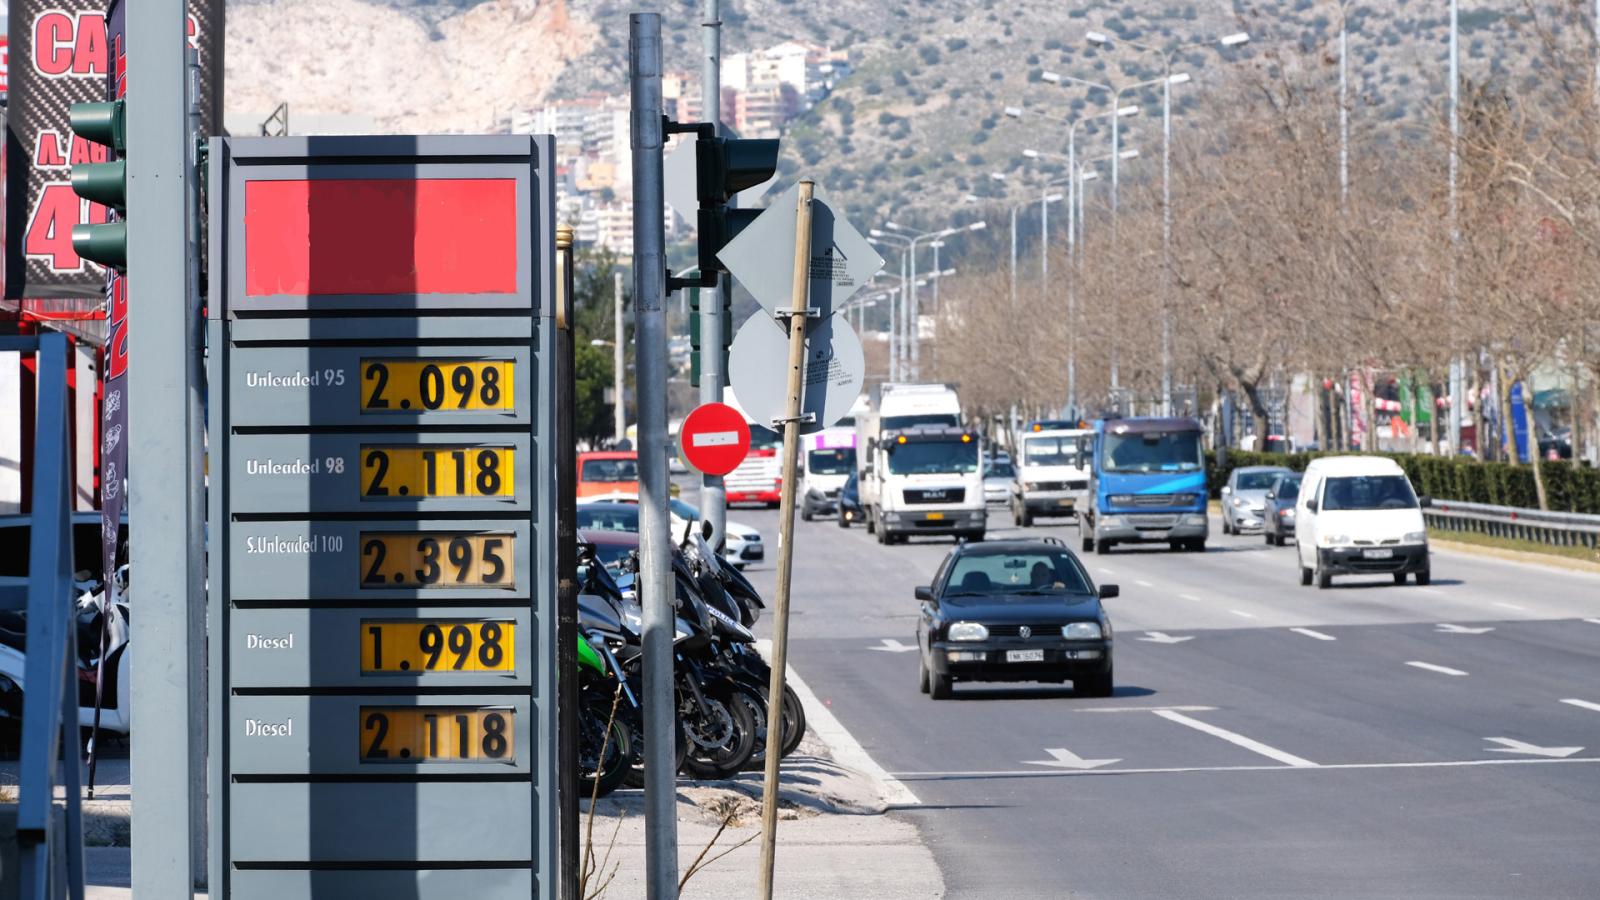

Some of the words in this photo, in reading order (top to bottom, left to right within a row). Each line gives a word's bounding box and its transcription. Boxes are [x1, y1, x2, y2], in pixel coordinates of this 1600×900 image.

[246, 370, 319, 388] Unleaded
[324, 369, 345, 387] 95
[365, 362, 501, 411] 2.098
[246, 457, 319, 475] Unleaded
[325, 456, 345, 474] 98
[365, 449, 501, 497] 2.118
[246, 535, 318, 554] S.Unleaded
[322, 535, 343, 553] 100
[363, 537, 505, 585] 2.395
[246, 633, 294, 650] Diesel
[368, 621, 503, 672] 1.998
[244, 719, 293, 737] Diesel
[364, 712, 507, 760] 2.118
